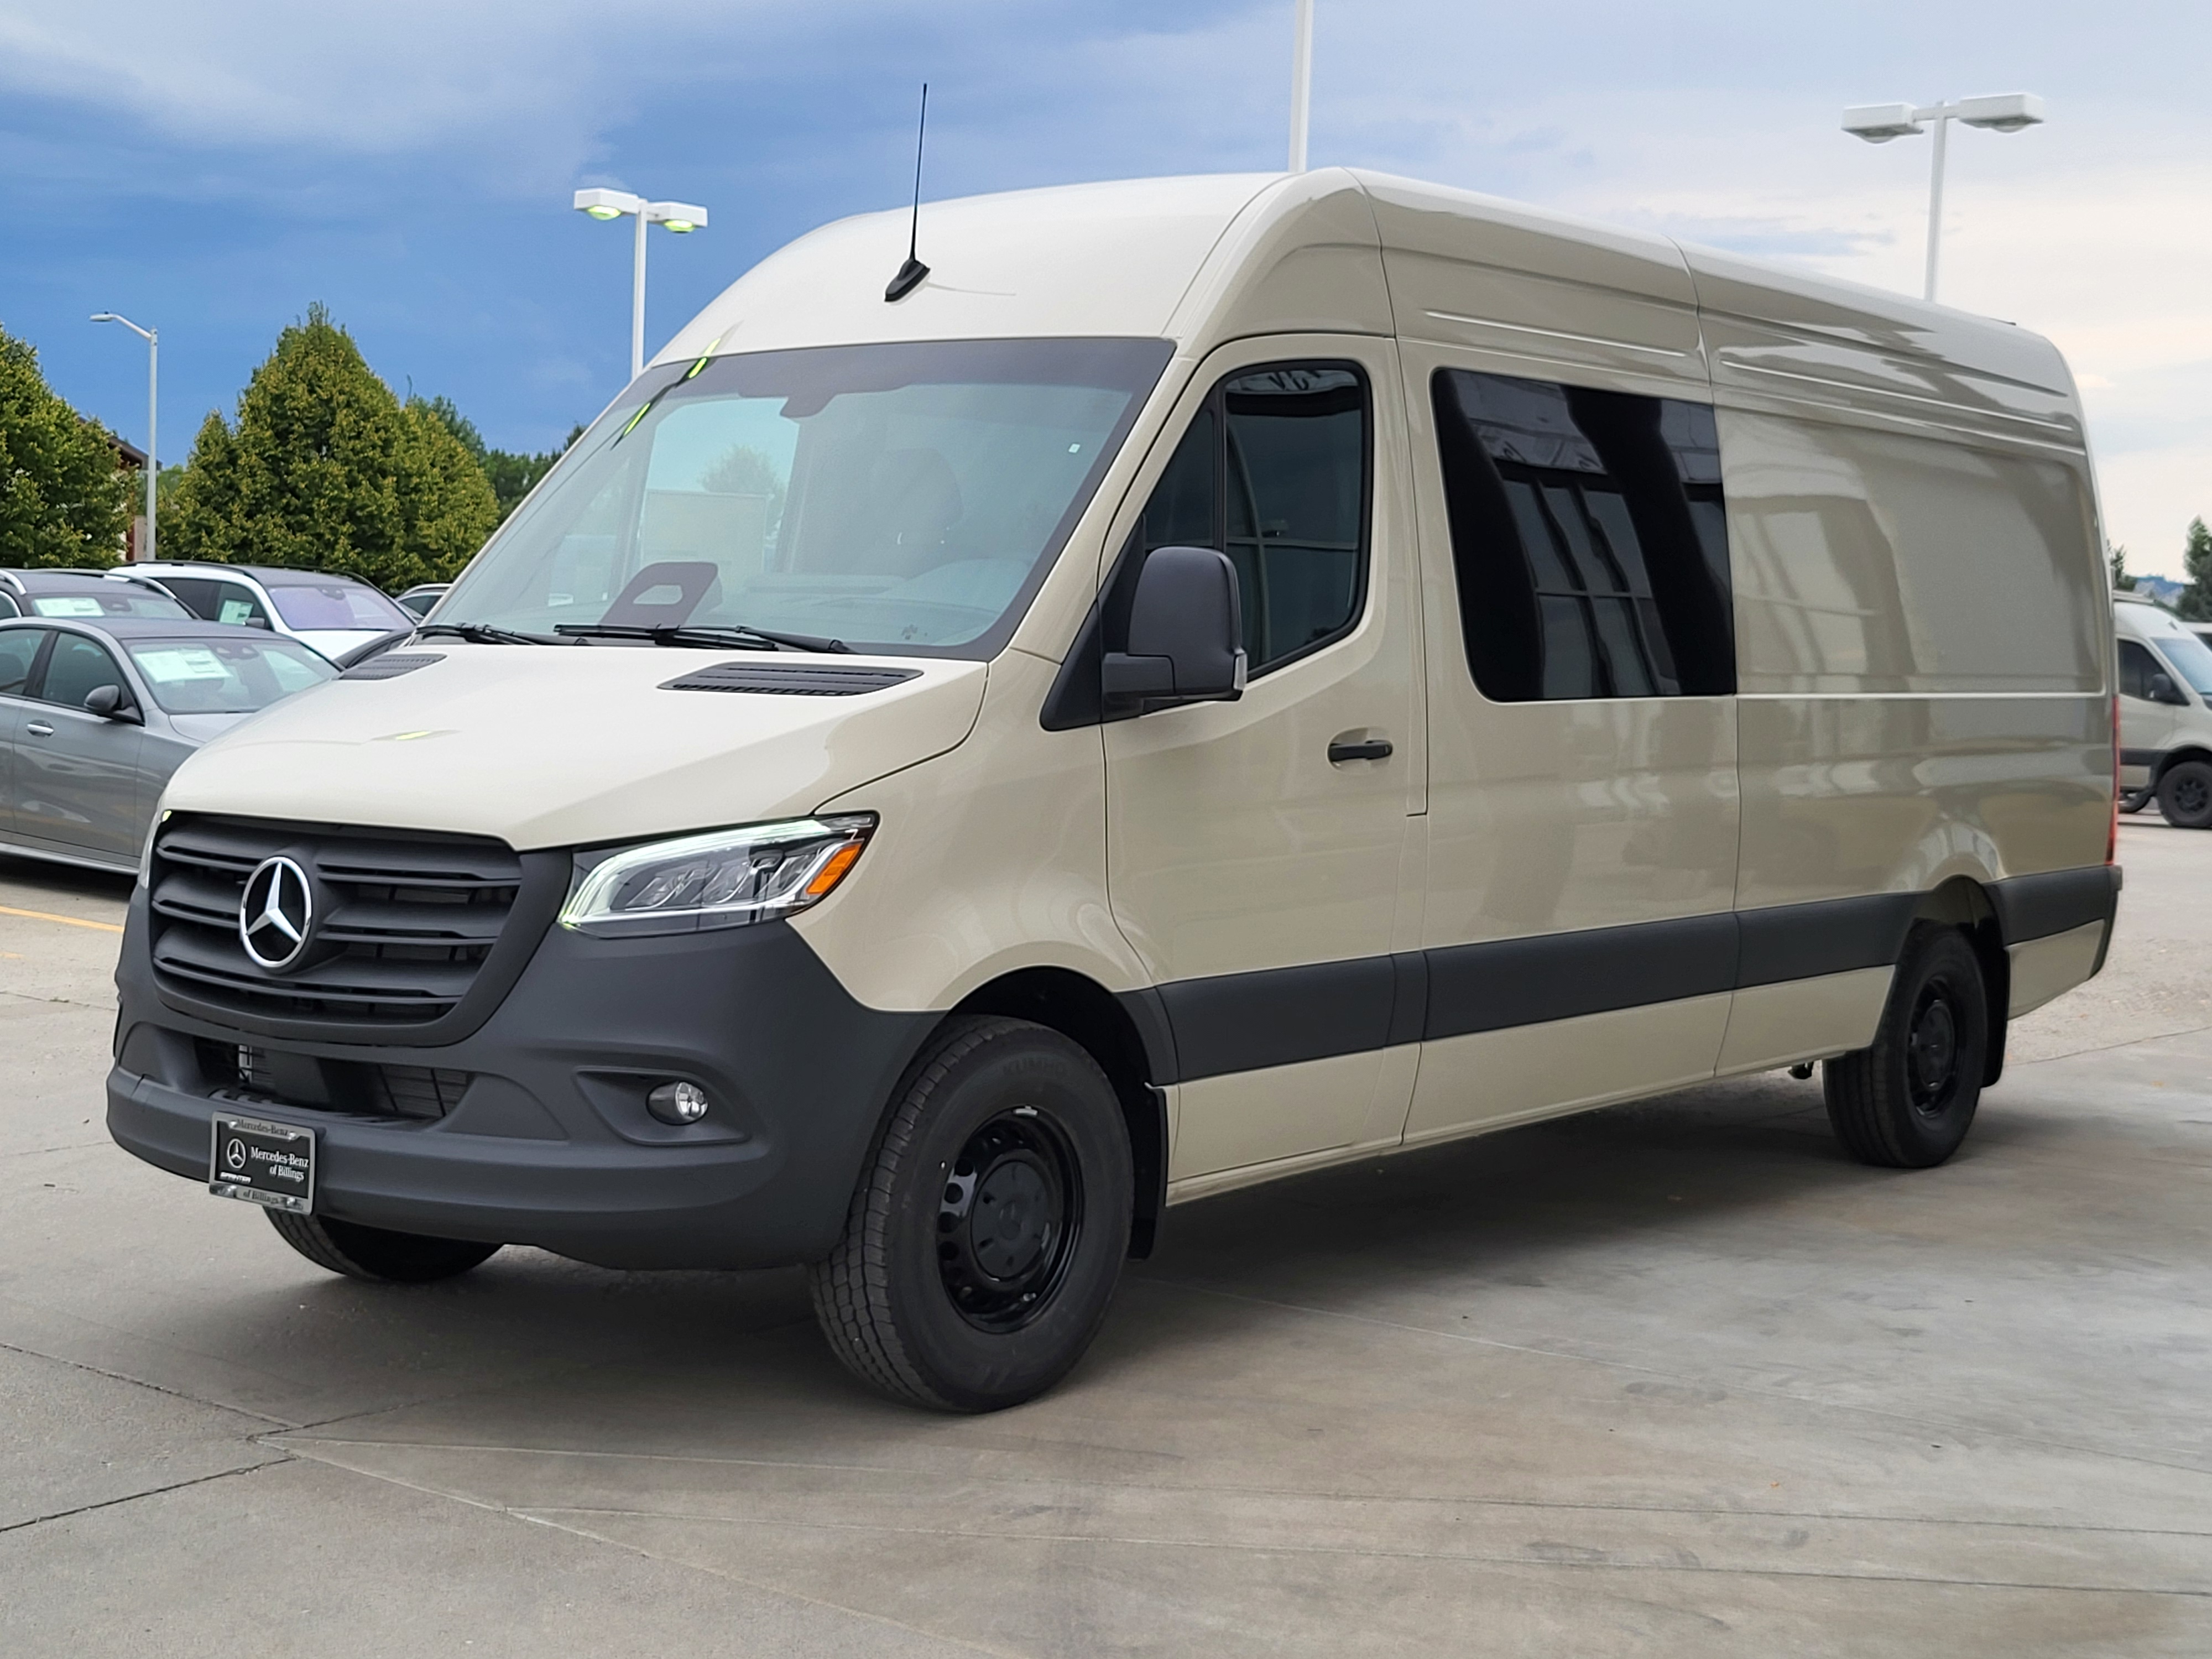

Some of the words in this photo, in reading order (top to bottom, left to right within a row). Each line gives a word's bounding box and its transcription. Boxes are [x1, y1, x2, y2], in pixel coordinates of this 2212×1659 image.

[237, 1118, 288, 1136] Mercedes-Benz
[251, 1146, 309, 1168] Mercedes-Benz
[269, 1165, 277, 1176] of
[278, 1166, 305, 1183] Billings
[243, 1190, 251, 1198] of
[252, 1190, 279, 1204] Billings
